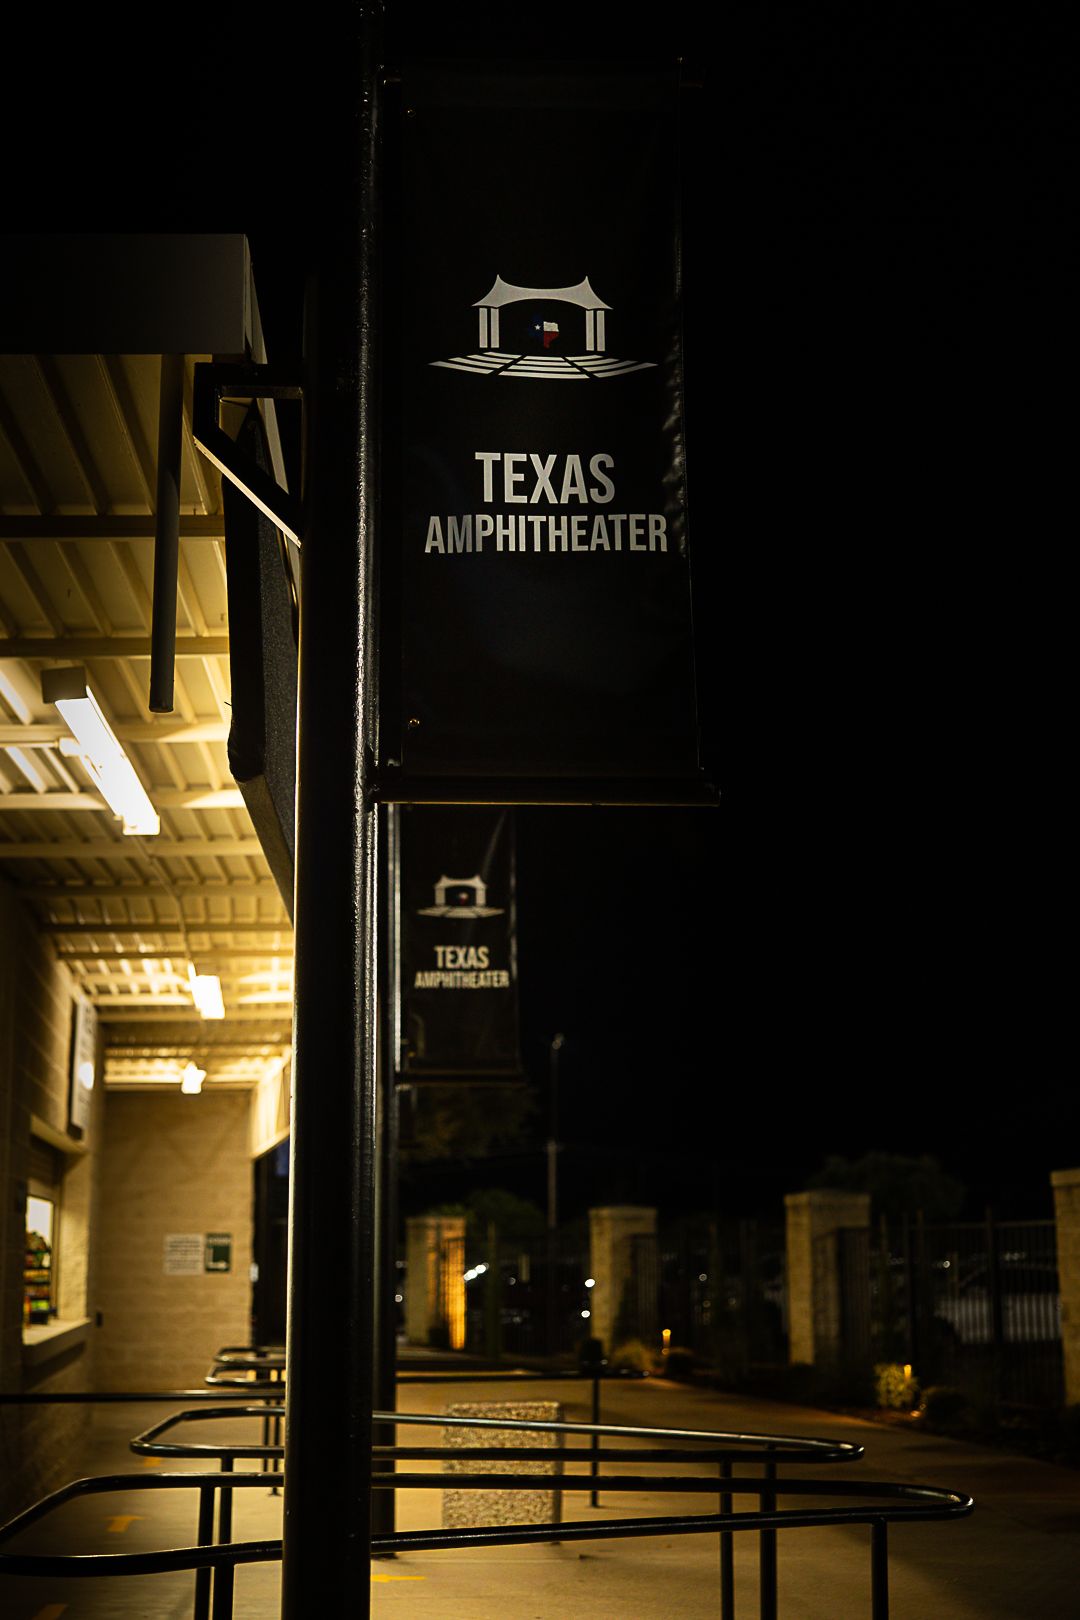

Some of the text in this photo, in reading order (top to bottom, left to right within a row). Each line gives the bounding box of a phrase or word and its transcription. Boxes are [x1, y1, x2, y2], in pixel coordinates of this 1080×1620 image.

[474, 451, 615, 504] TEXAS
[424, 513, 668, 554] AMPHITHEATER
[433, 945, 490, 969] TEXAS
[414, 970, 510, 989] AMPHITHEATER
